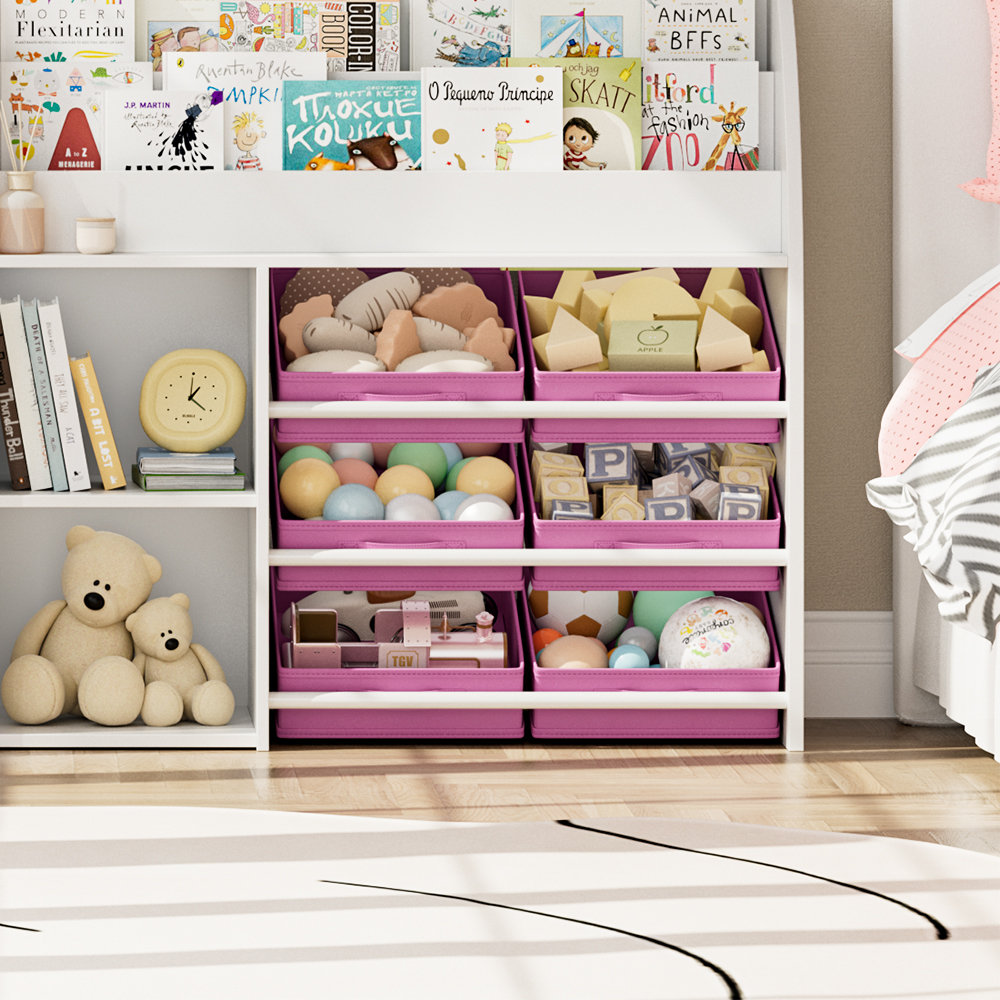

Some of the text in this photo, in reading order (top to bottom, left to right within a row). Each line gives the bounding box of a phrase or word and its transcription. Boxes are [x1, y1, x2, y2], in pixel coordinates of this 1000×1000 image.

[16, 9, 125, 19] MODERN
[18, 20, 124, 37] Flexitarian
[321, 14, 345, 55] BOOK
[140, 101, 171, 109] MARTIN
[429, 81, 439, 100] O
[443, 80, 494, 105] Pequeno
[570, 78, 637, 113] SKATT
[647, 110, 709, 142] fashion
[58, 160, 95, 168] MENAGERIE
[65, 147, 72, 158] A
[81, 147, 88, 157] Z
[31, 323, 42, 352] DEATH
[40, 379, 52, 426] SALESMAN
[89, 407, 100, 416] A
[99, 441, 114, 468] LOST
[591, 448, 625, 477] P
[392, 656, 414, 668] TGV
